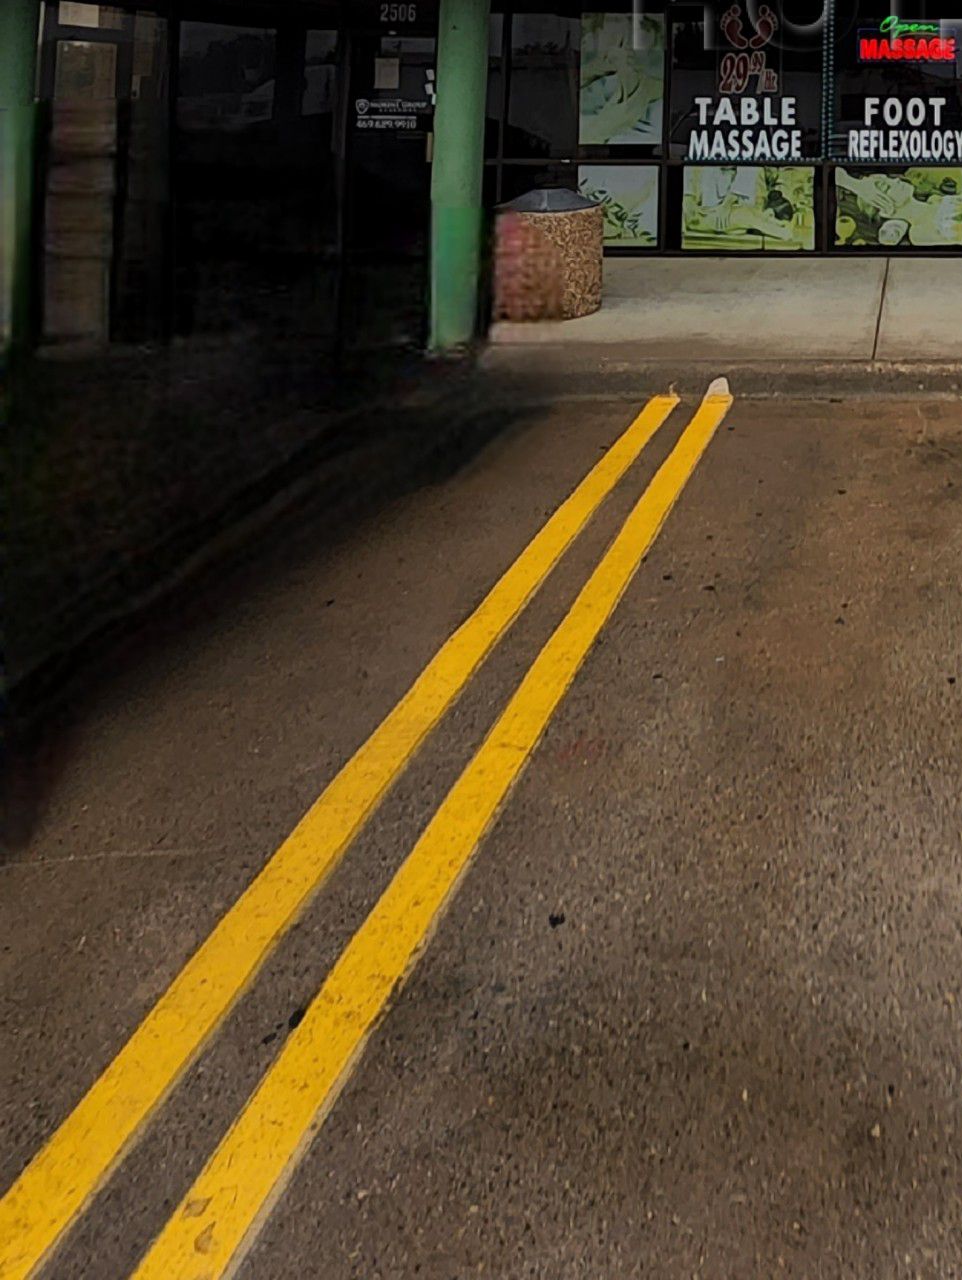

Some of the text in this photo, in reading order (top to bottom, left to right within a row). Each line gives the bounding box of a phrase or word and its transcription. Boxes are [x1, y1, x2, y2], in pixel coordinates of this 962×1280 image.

[380, 3, 417, 22] 2506
[879, 15, 939, 38] Open
[859, 38, 956, 60] MASSAGE
[694, 97, 796, 126] TABLE
[864, 97, 947, 127] FOOT
[688, 129, 802, 161] MASSAGE
